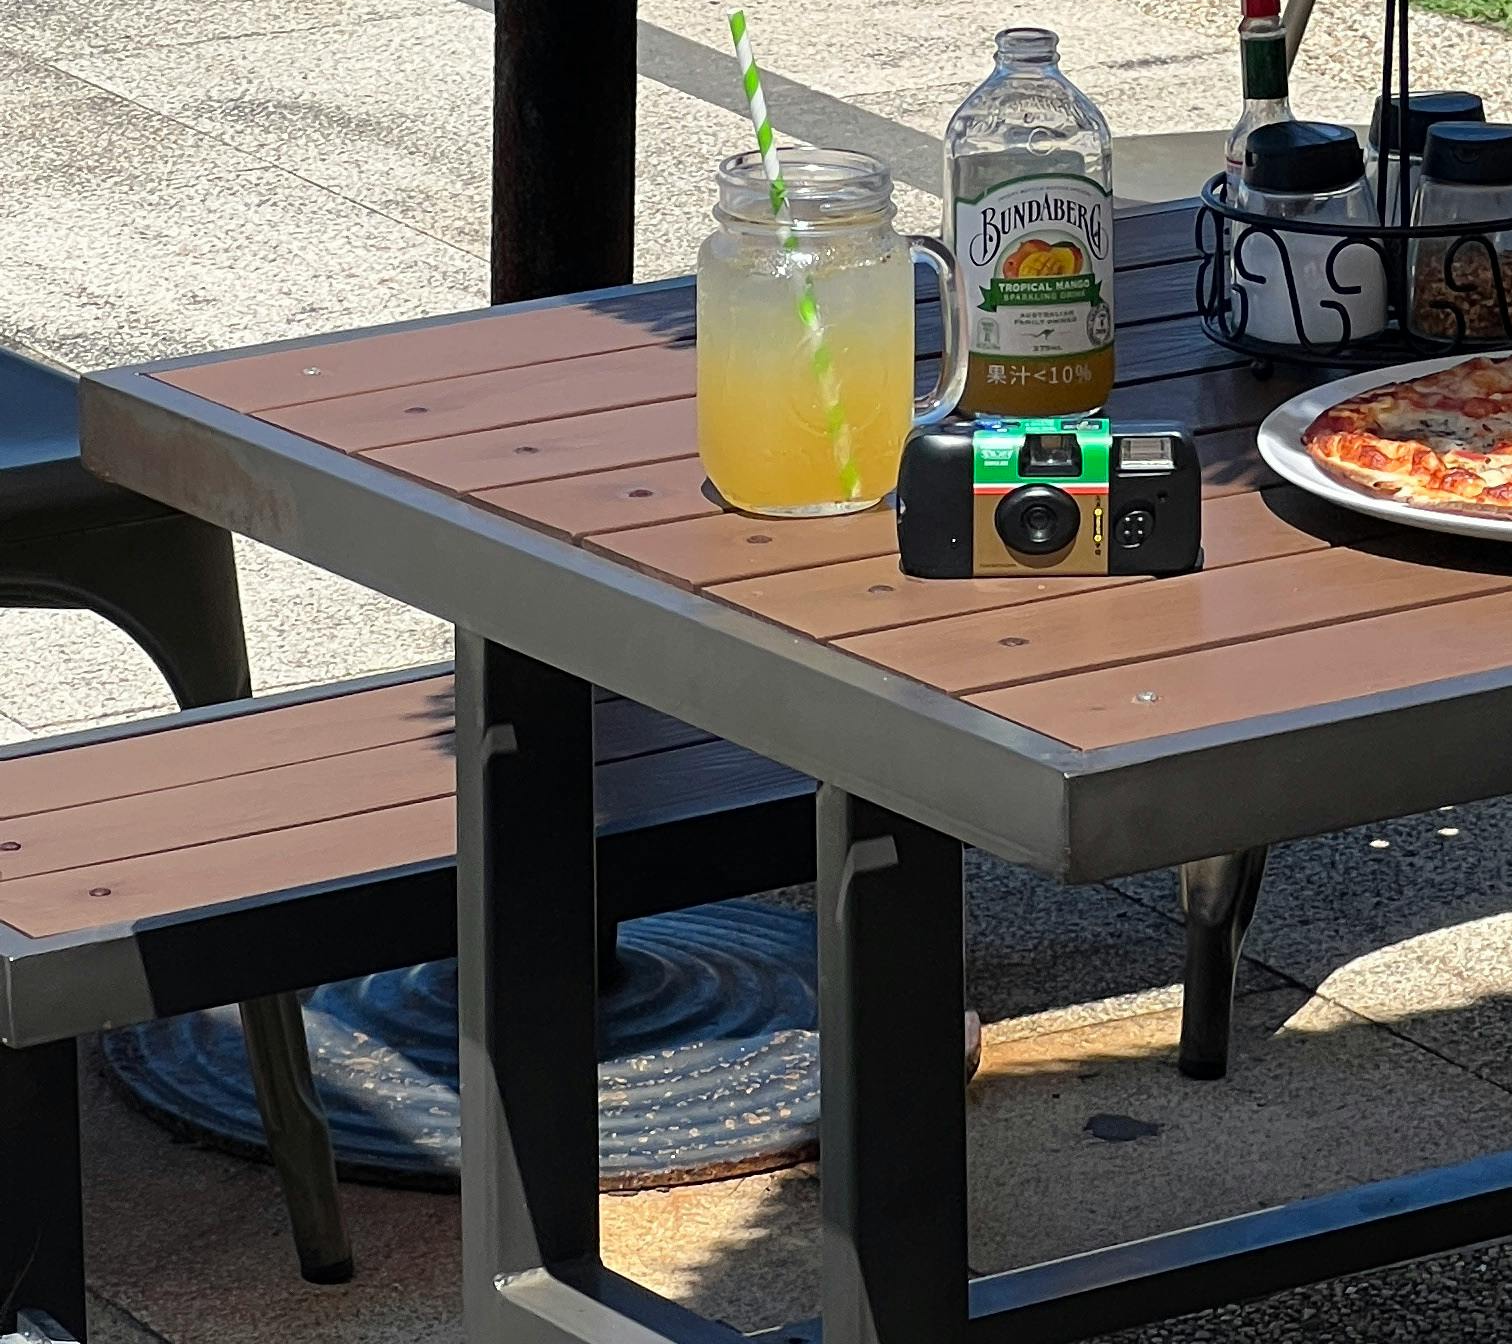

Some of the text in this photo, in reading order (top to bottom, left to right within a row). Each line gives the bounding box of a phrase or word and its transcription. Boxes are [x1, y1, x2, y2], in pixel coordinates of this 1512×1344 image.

[969, 192, 1109, 266] BUNDABERG
[998, 279, 1090, 293] TROPICAL MANGO
[1003, 291, 1057, 301] SPARKLING
[1020, 309, 1074, 318] AUSTRALIAN
[1014, 318, 1045, 326] FAMILY
[986, 363, 1092, 386] 果汁<10%
